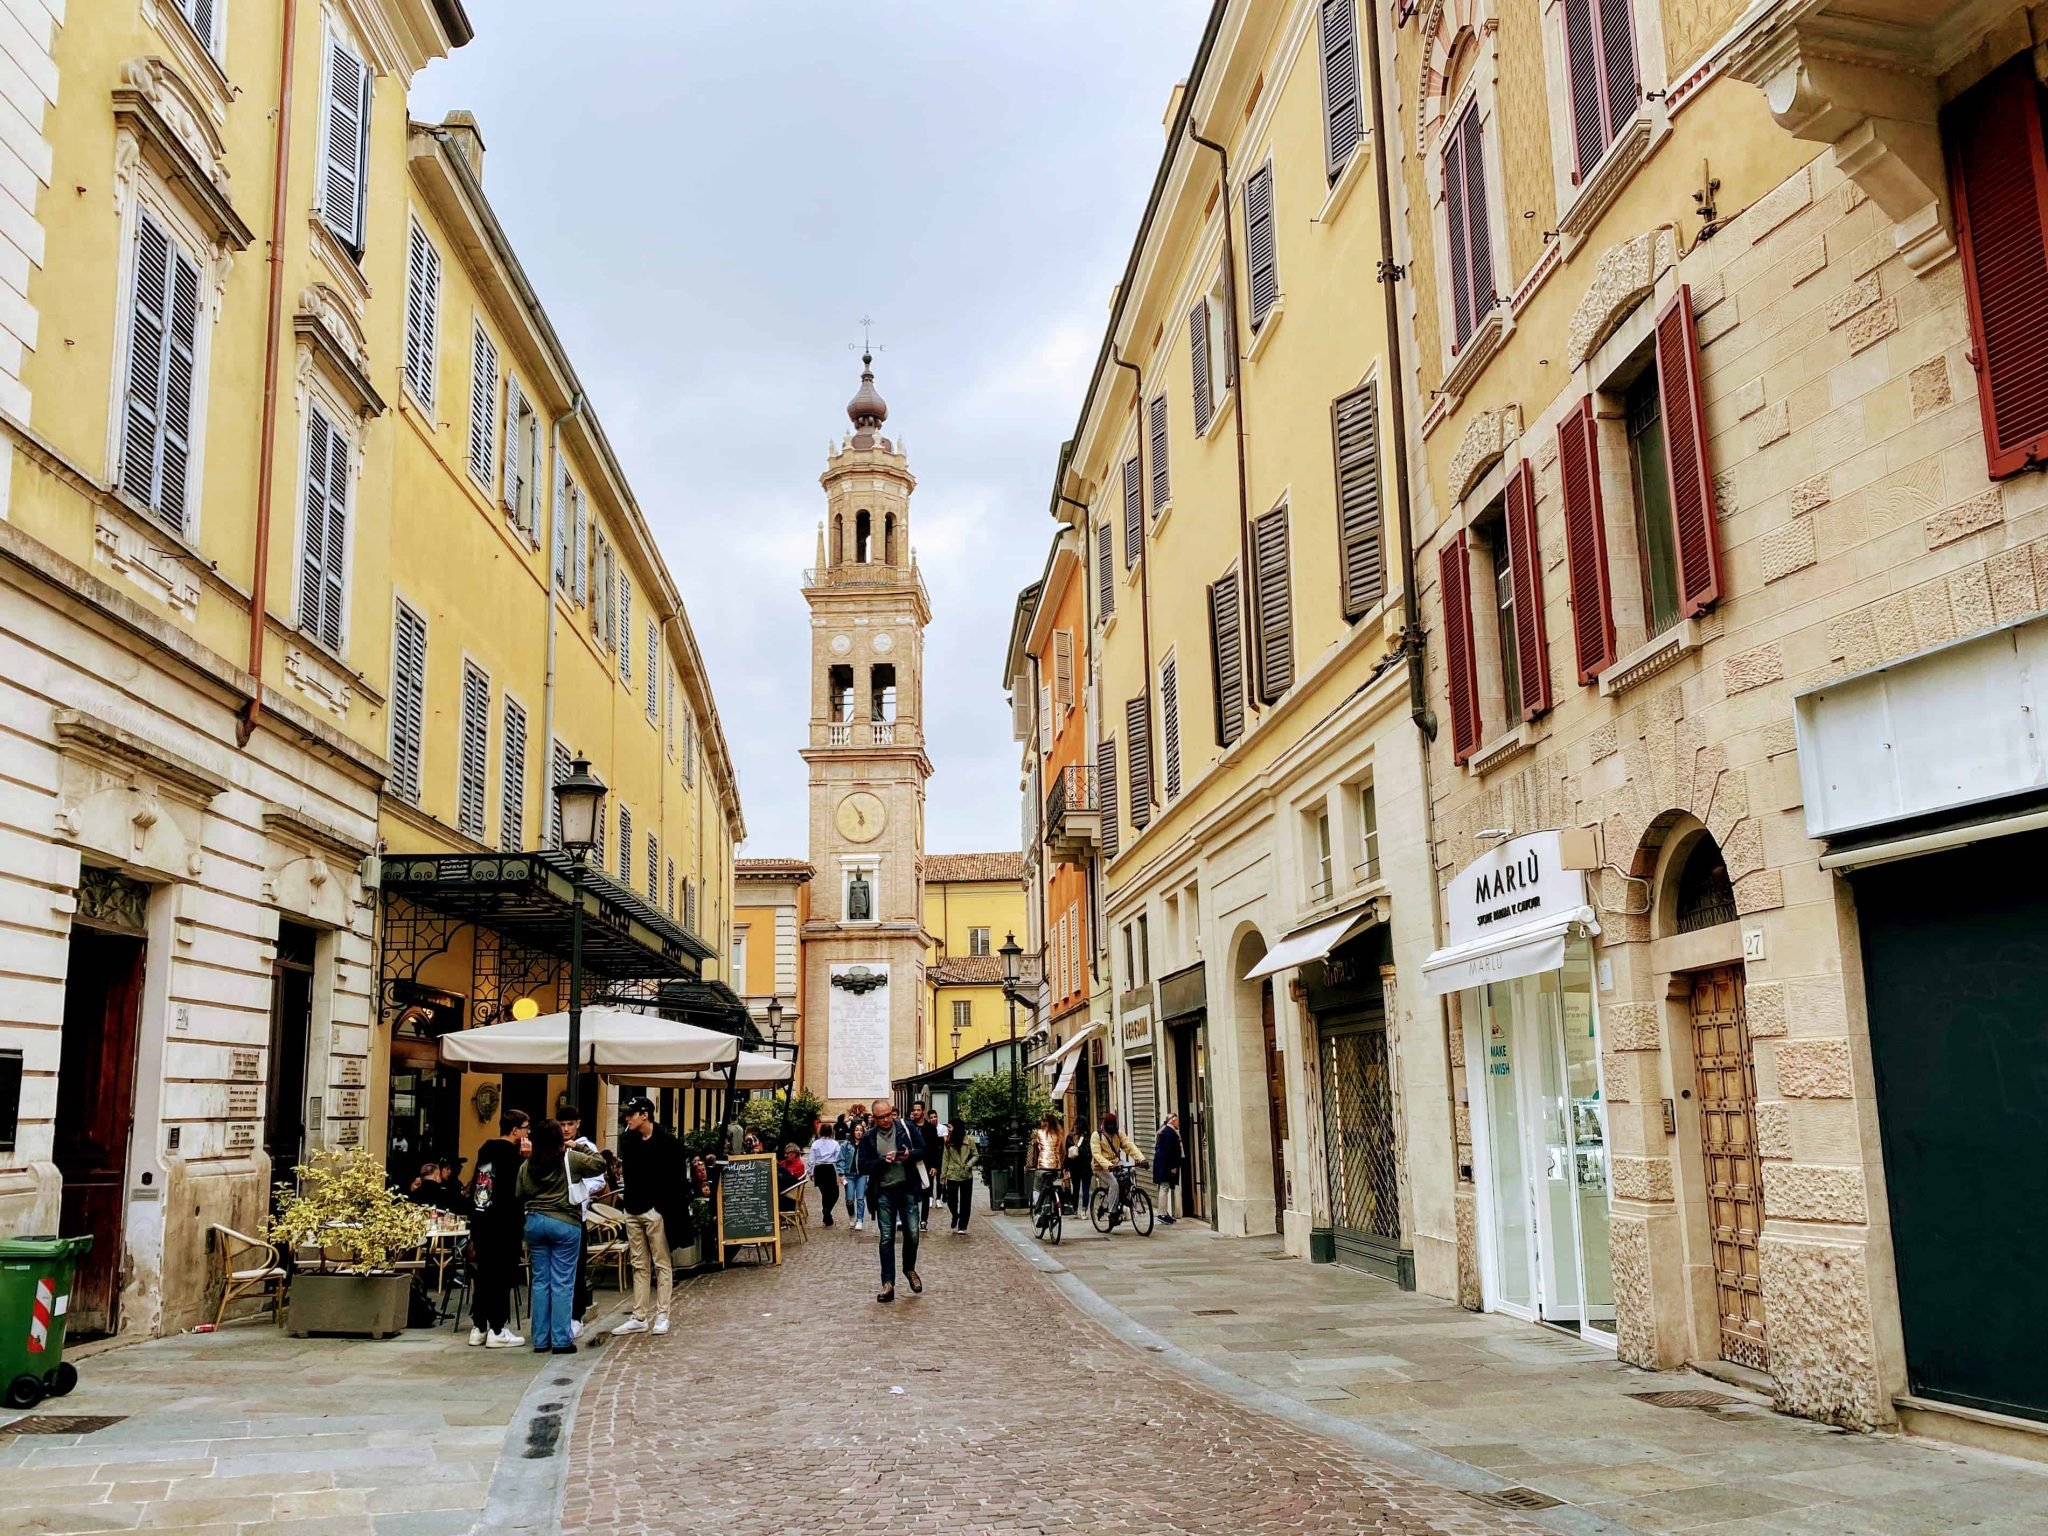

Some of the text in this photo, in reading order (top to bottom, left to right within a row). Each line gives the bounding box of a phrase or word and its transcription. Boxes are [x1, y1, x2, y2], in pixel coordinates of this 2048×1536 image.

[1475, 848, 1540, 904] MARLÙ
[1745, 934, 1761, 955] 27
[1490, 1045, 1507, 1057] MAKE
[1489, 1063, 1510, 1075] A WISH
